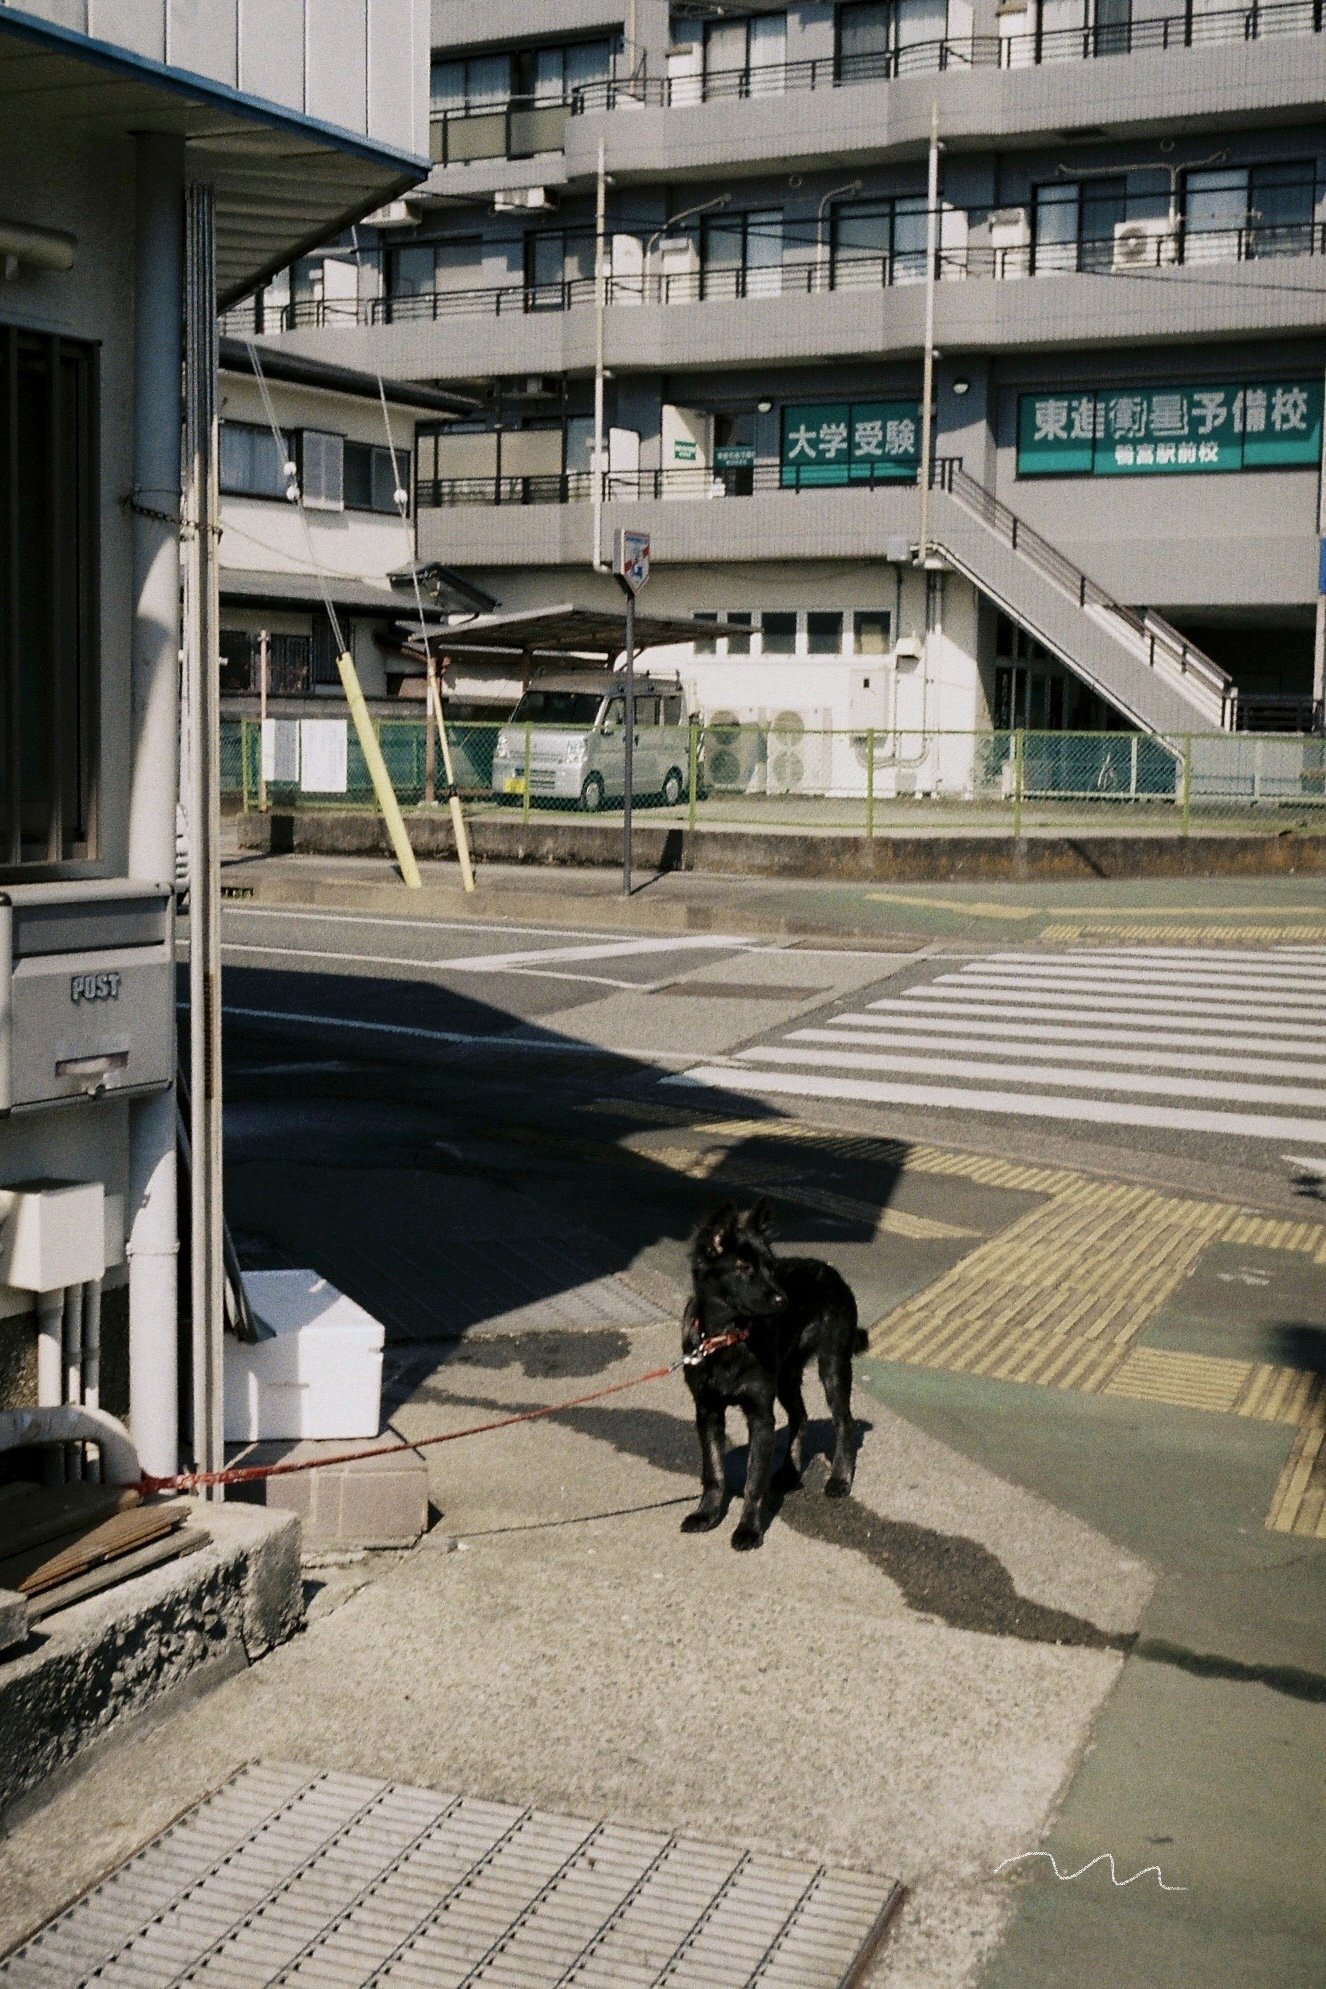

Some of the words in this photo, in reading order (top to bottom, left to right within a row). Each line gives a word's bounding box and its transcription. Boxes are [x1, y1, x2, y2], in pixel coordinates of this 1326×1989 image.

[1034, 387, 1307, 440] 東進衛星予備校
[788, 418, 915, 459] 大学受験
[71, 973, 121, 1002] POST
